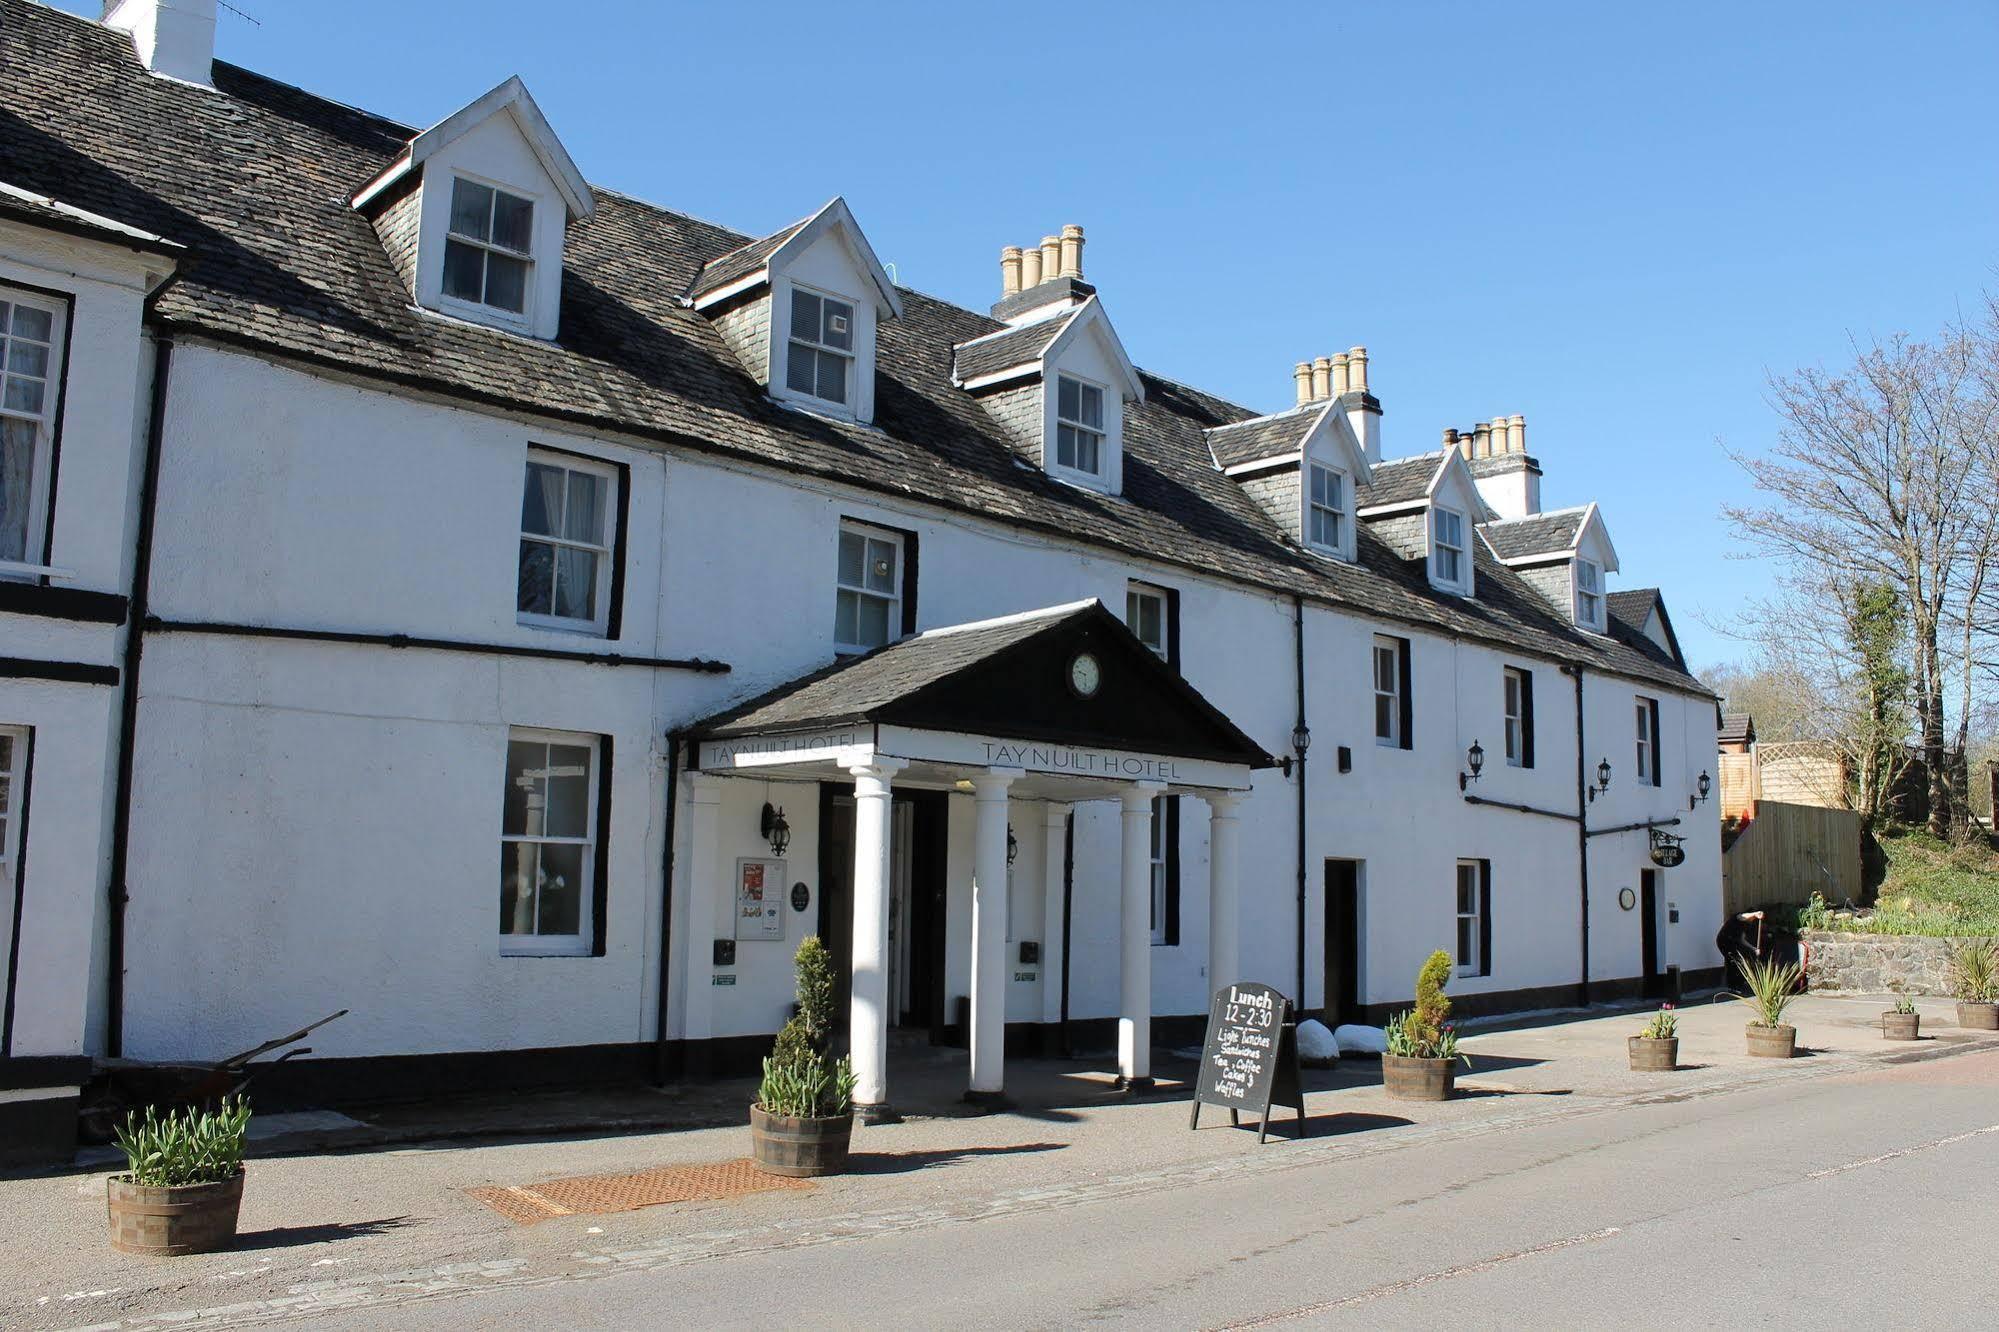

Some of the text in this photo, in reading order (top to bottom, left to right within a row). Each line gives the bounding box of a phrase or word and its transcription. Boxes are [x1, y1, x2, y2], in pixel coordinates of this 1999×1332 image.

[982, 742, 1181, 779] TAYNUILT HOTEL
[1230, 986, 1272, 1010] Lunch
[1217, 1028, 1239, 1046] Light
[1222, 1067, 1245, 1082] Cakes
[1214, 1080, 1244, 1098] Waffles
